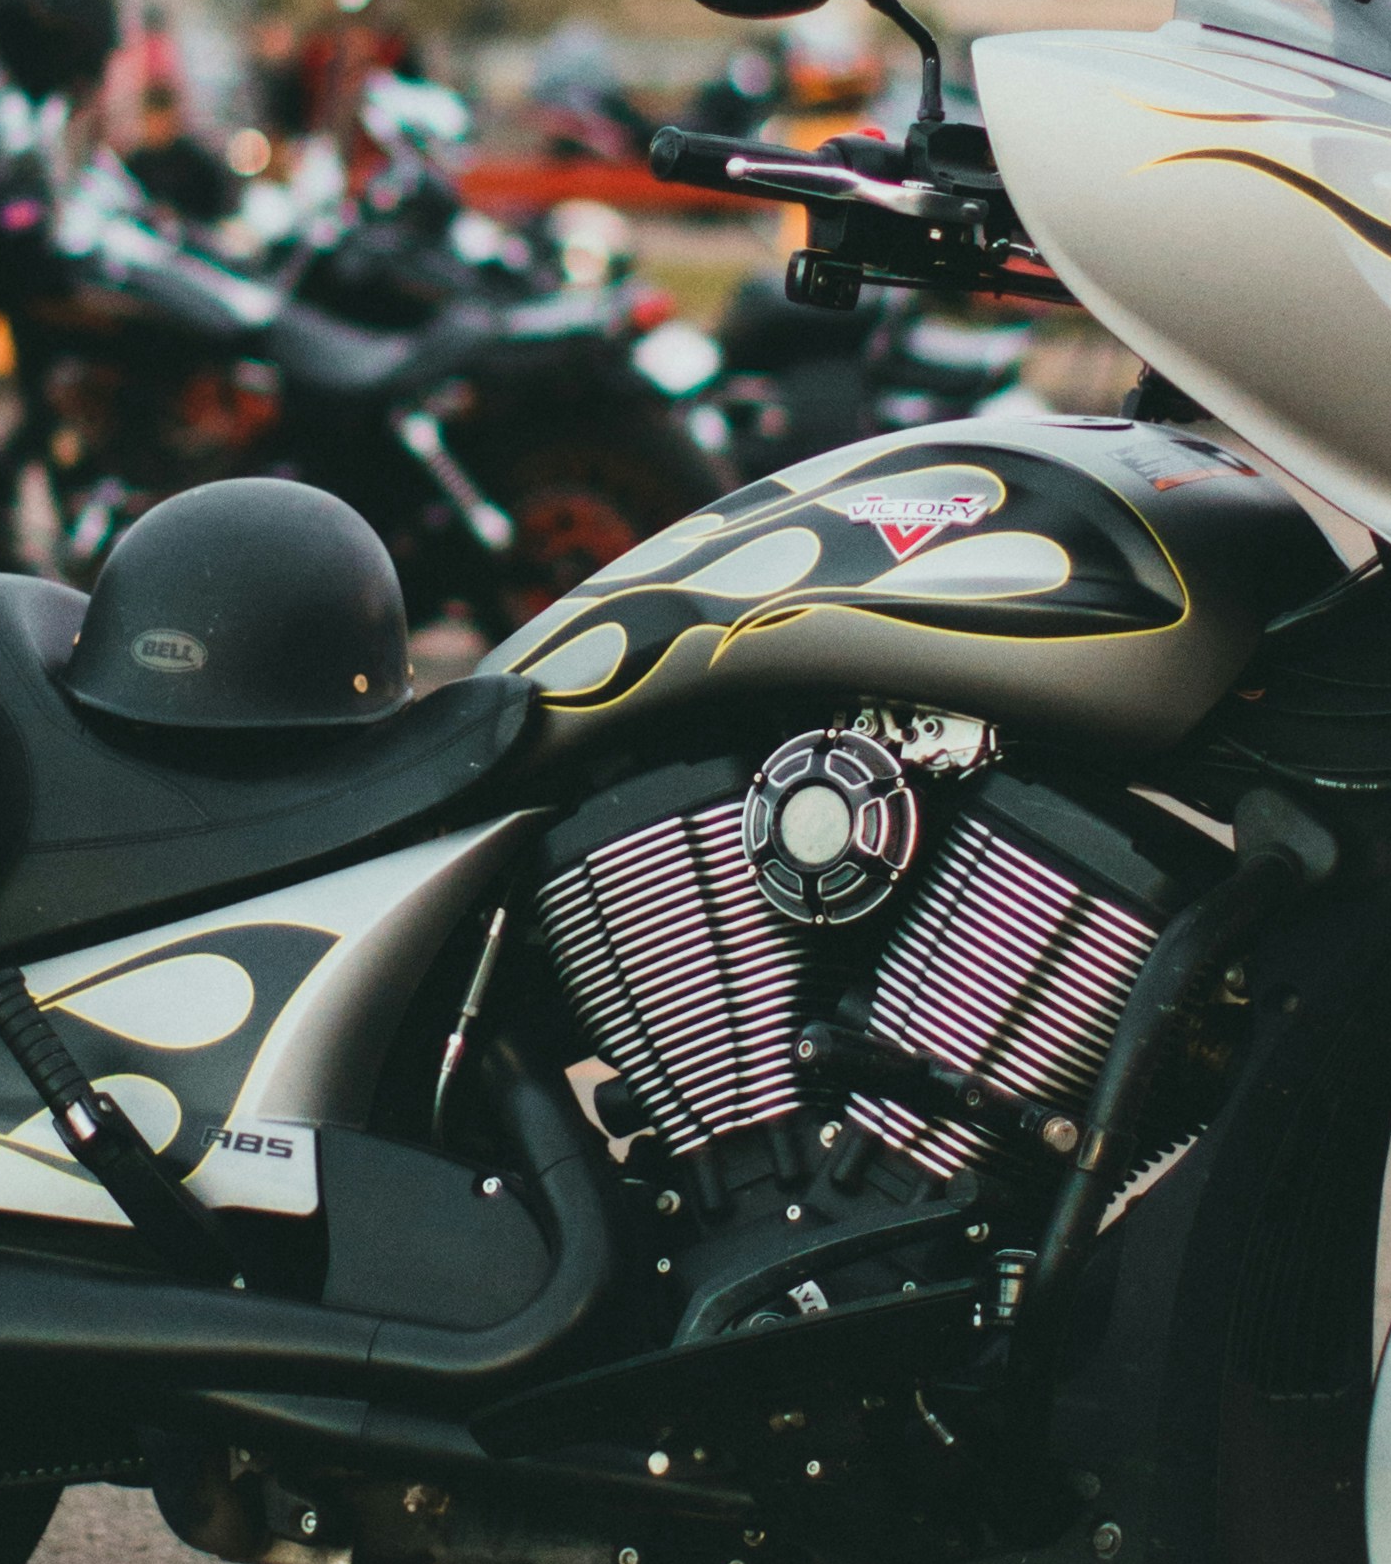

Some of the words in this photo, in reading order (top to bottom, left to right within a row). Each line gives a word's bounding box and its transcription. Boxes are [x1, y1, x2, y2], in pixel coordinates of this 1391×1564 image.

[851, 501, 979, 519] VICTORY
[141, 639, 194, 663] BELL
[201, 1126, 294, 1160] ABS
